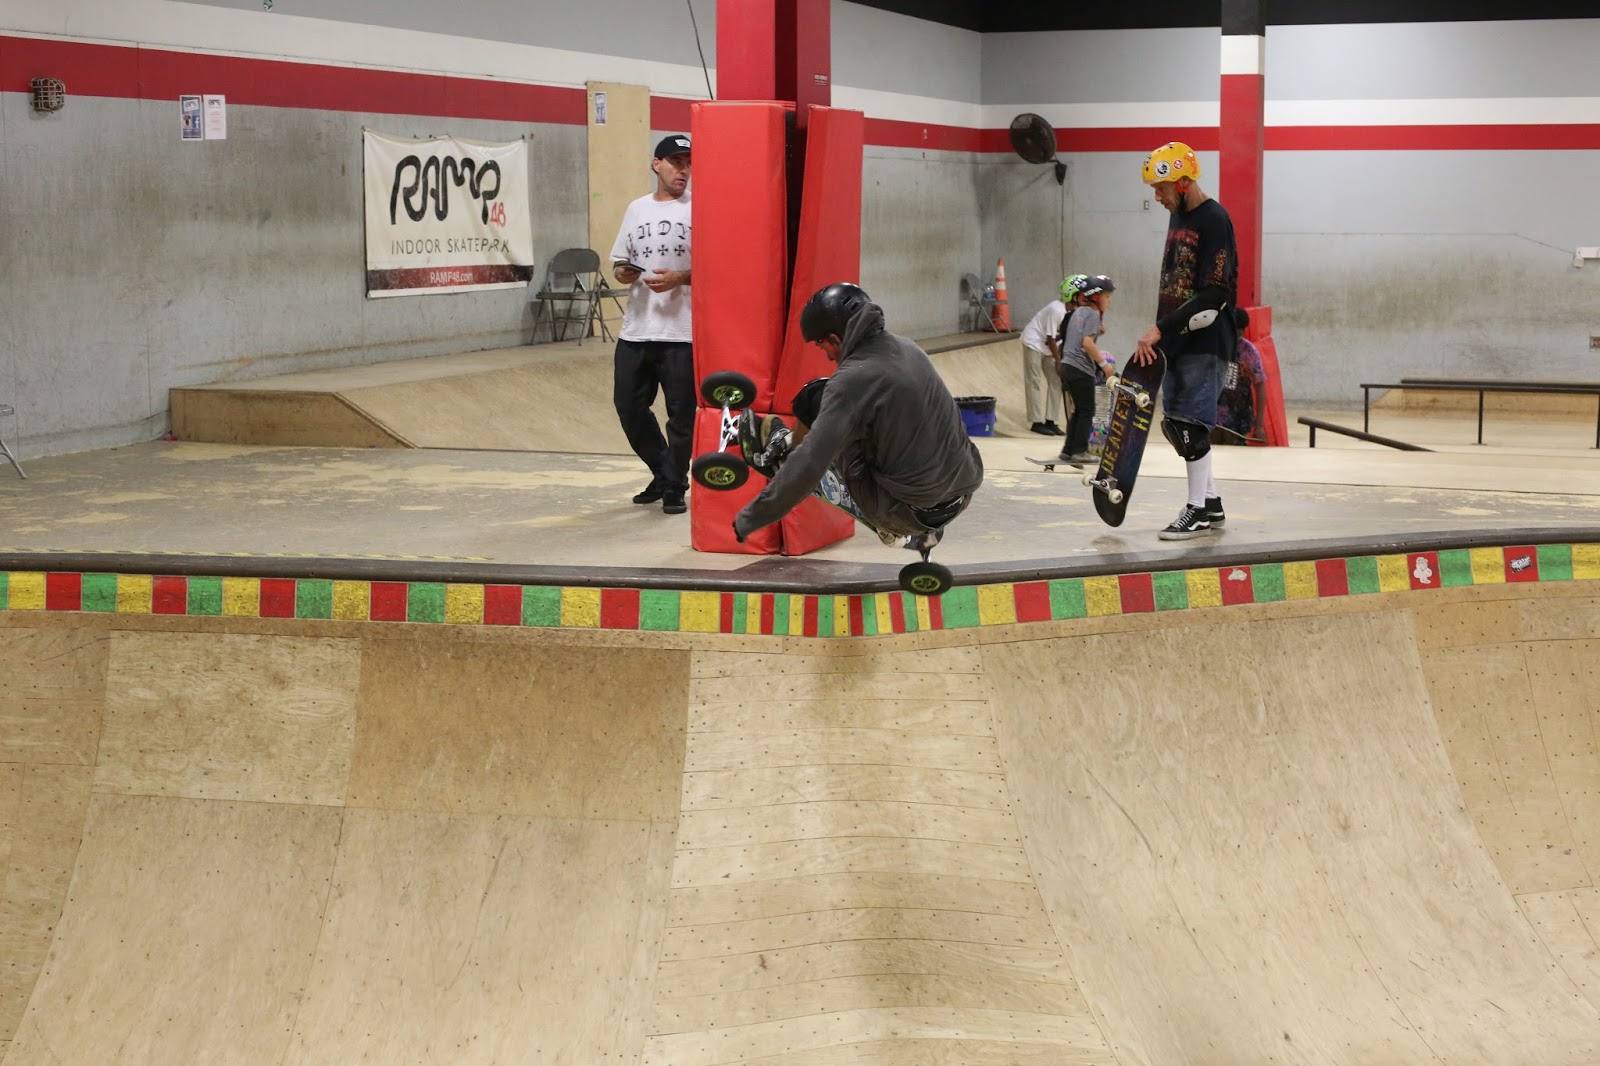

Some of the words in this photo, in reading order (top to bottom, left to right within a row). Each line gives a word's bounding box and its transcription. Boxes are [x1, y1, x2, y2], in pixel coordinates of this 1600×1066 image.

[390, 155, 501, 225] RAMP
[490, 201, 506, 227] 48
[391, 239, 441, 255] INDOOR
[447, 238, 510, 254] SKATEPARK
[430, 271, 473, 283] RAMP48.com
